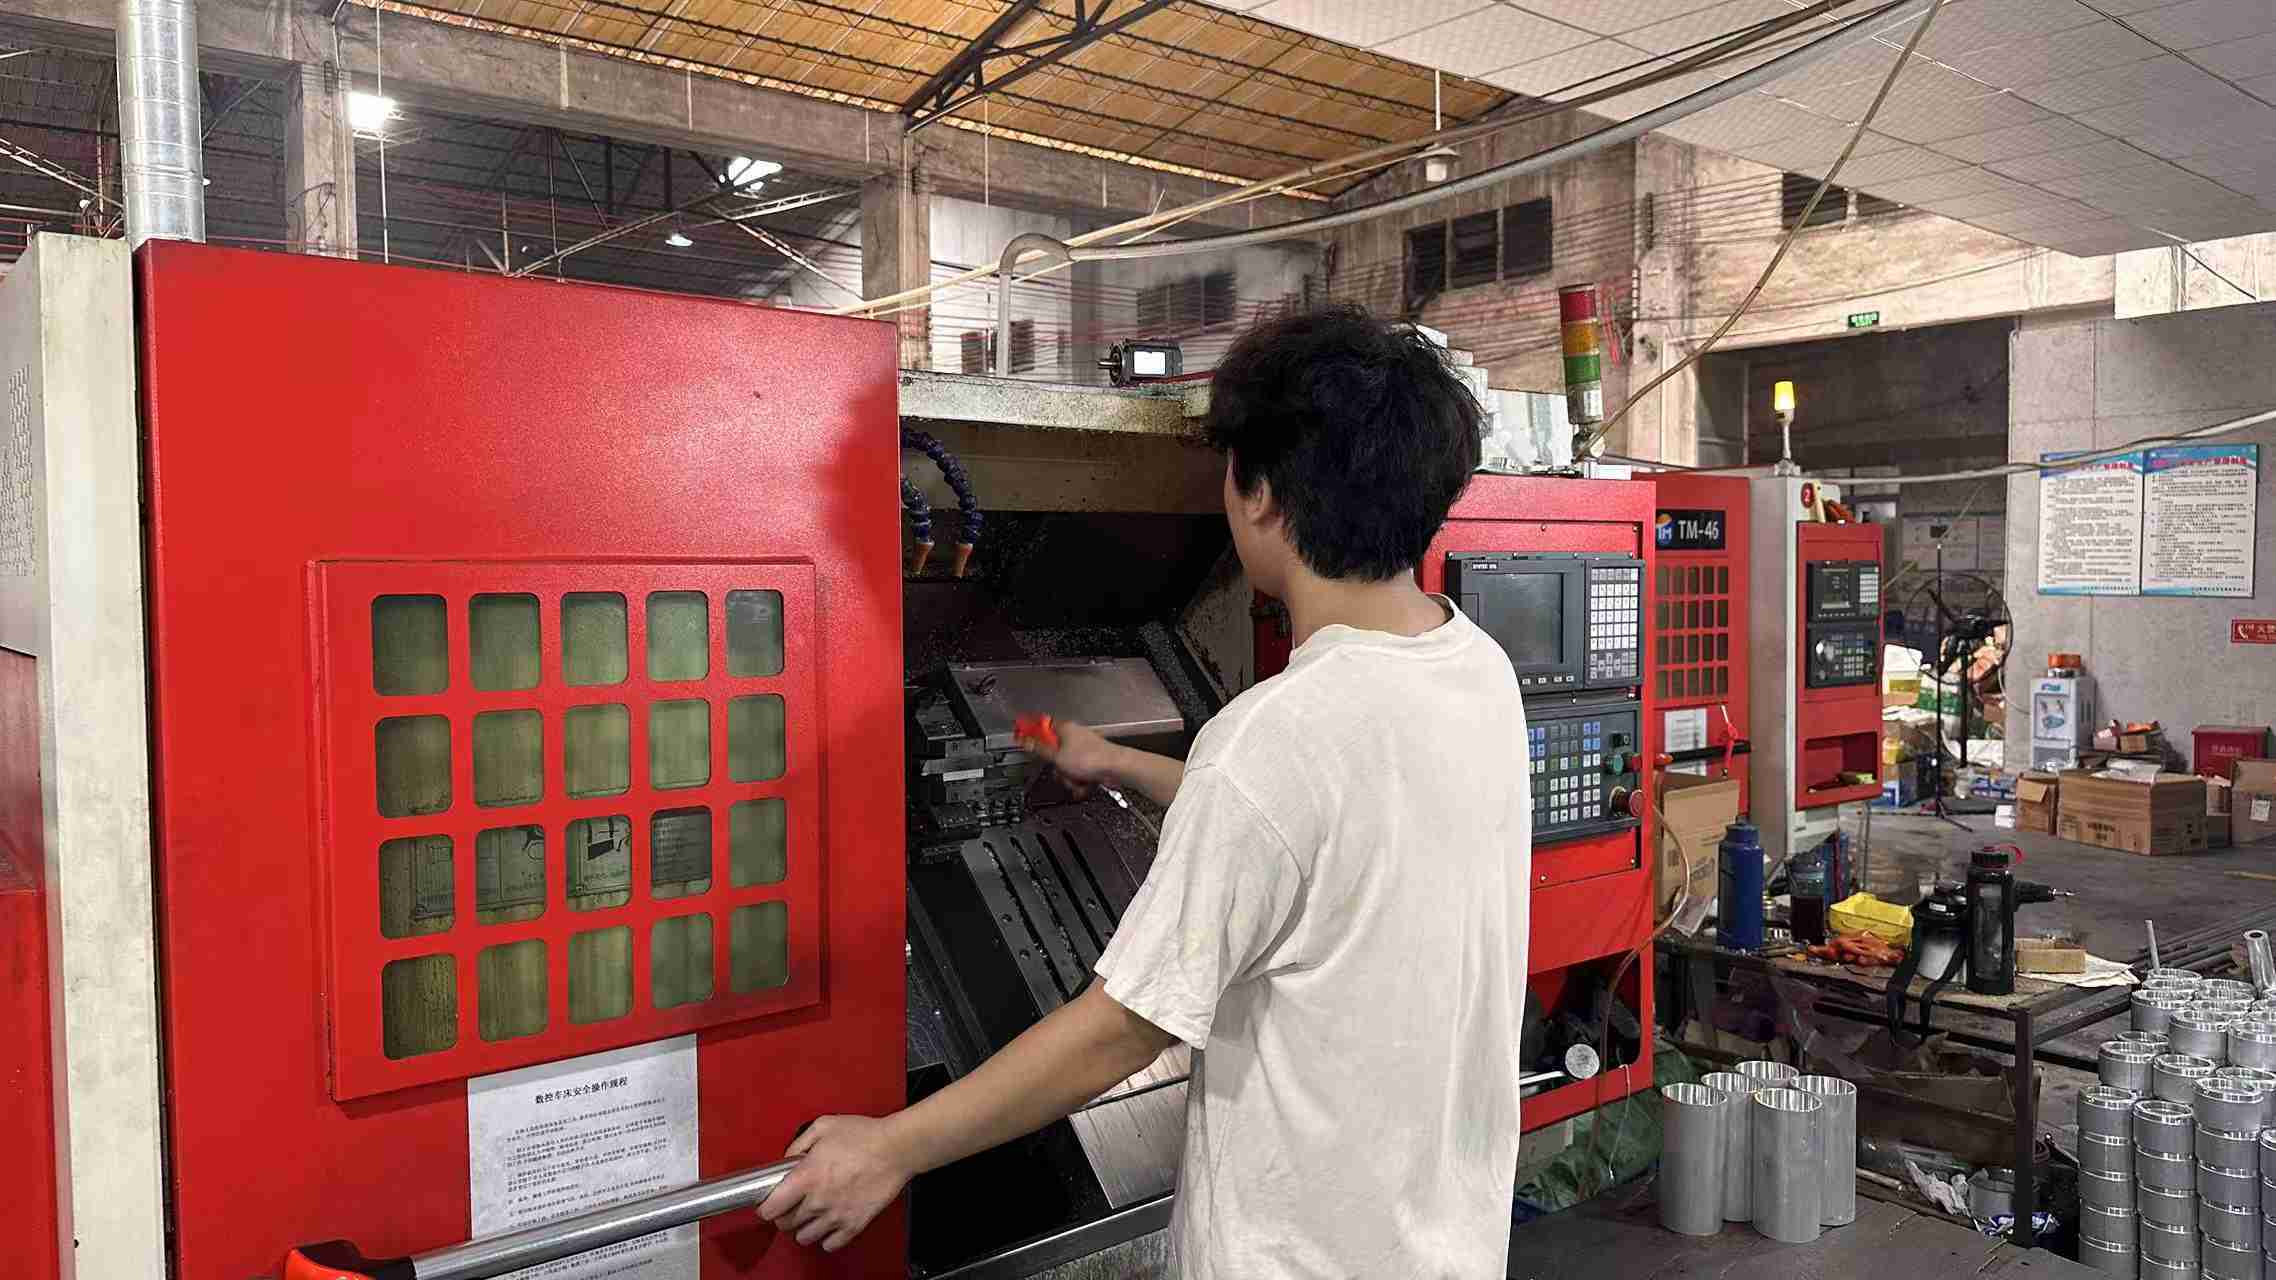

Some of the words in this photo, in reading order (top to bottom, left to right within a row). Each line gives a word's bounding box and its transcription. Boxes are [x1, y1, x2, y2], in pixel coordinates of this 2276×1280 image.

[1677, 519, 1719, 540] TM-46
[534, 1076, 629, 1105] 数控车床安全操作规程
